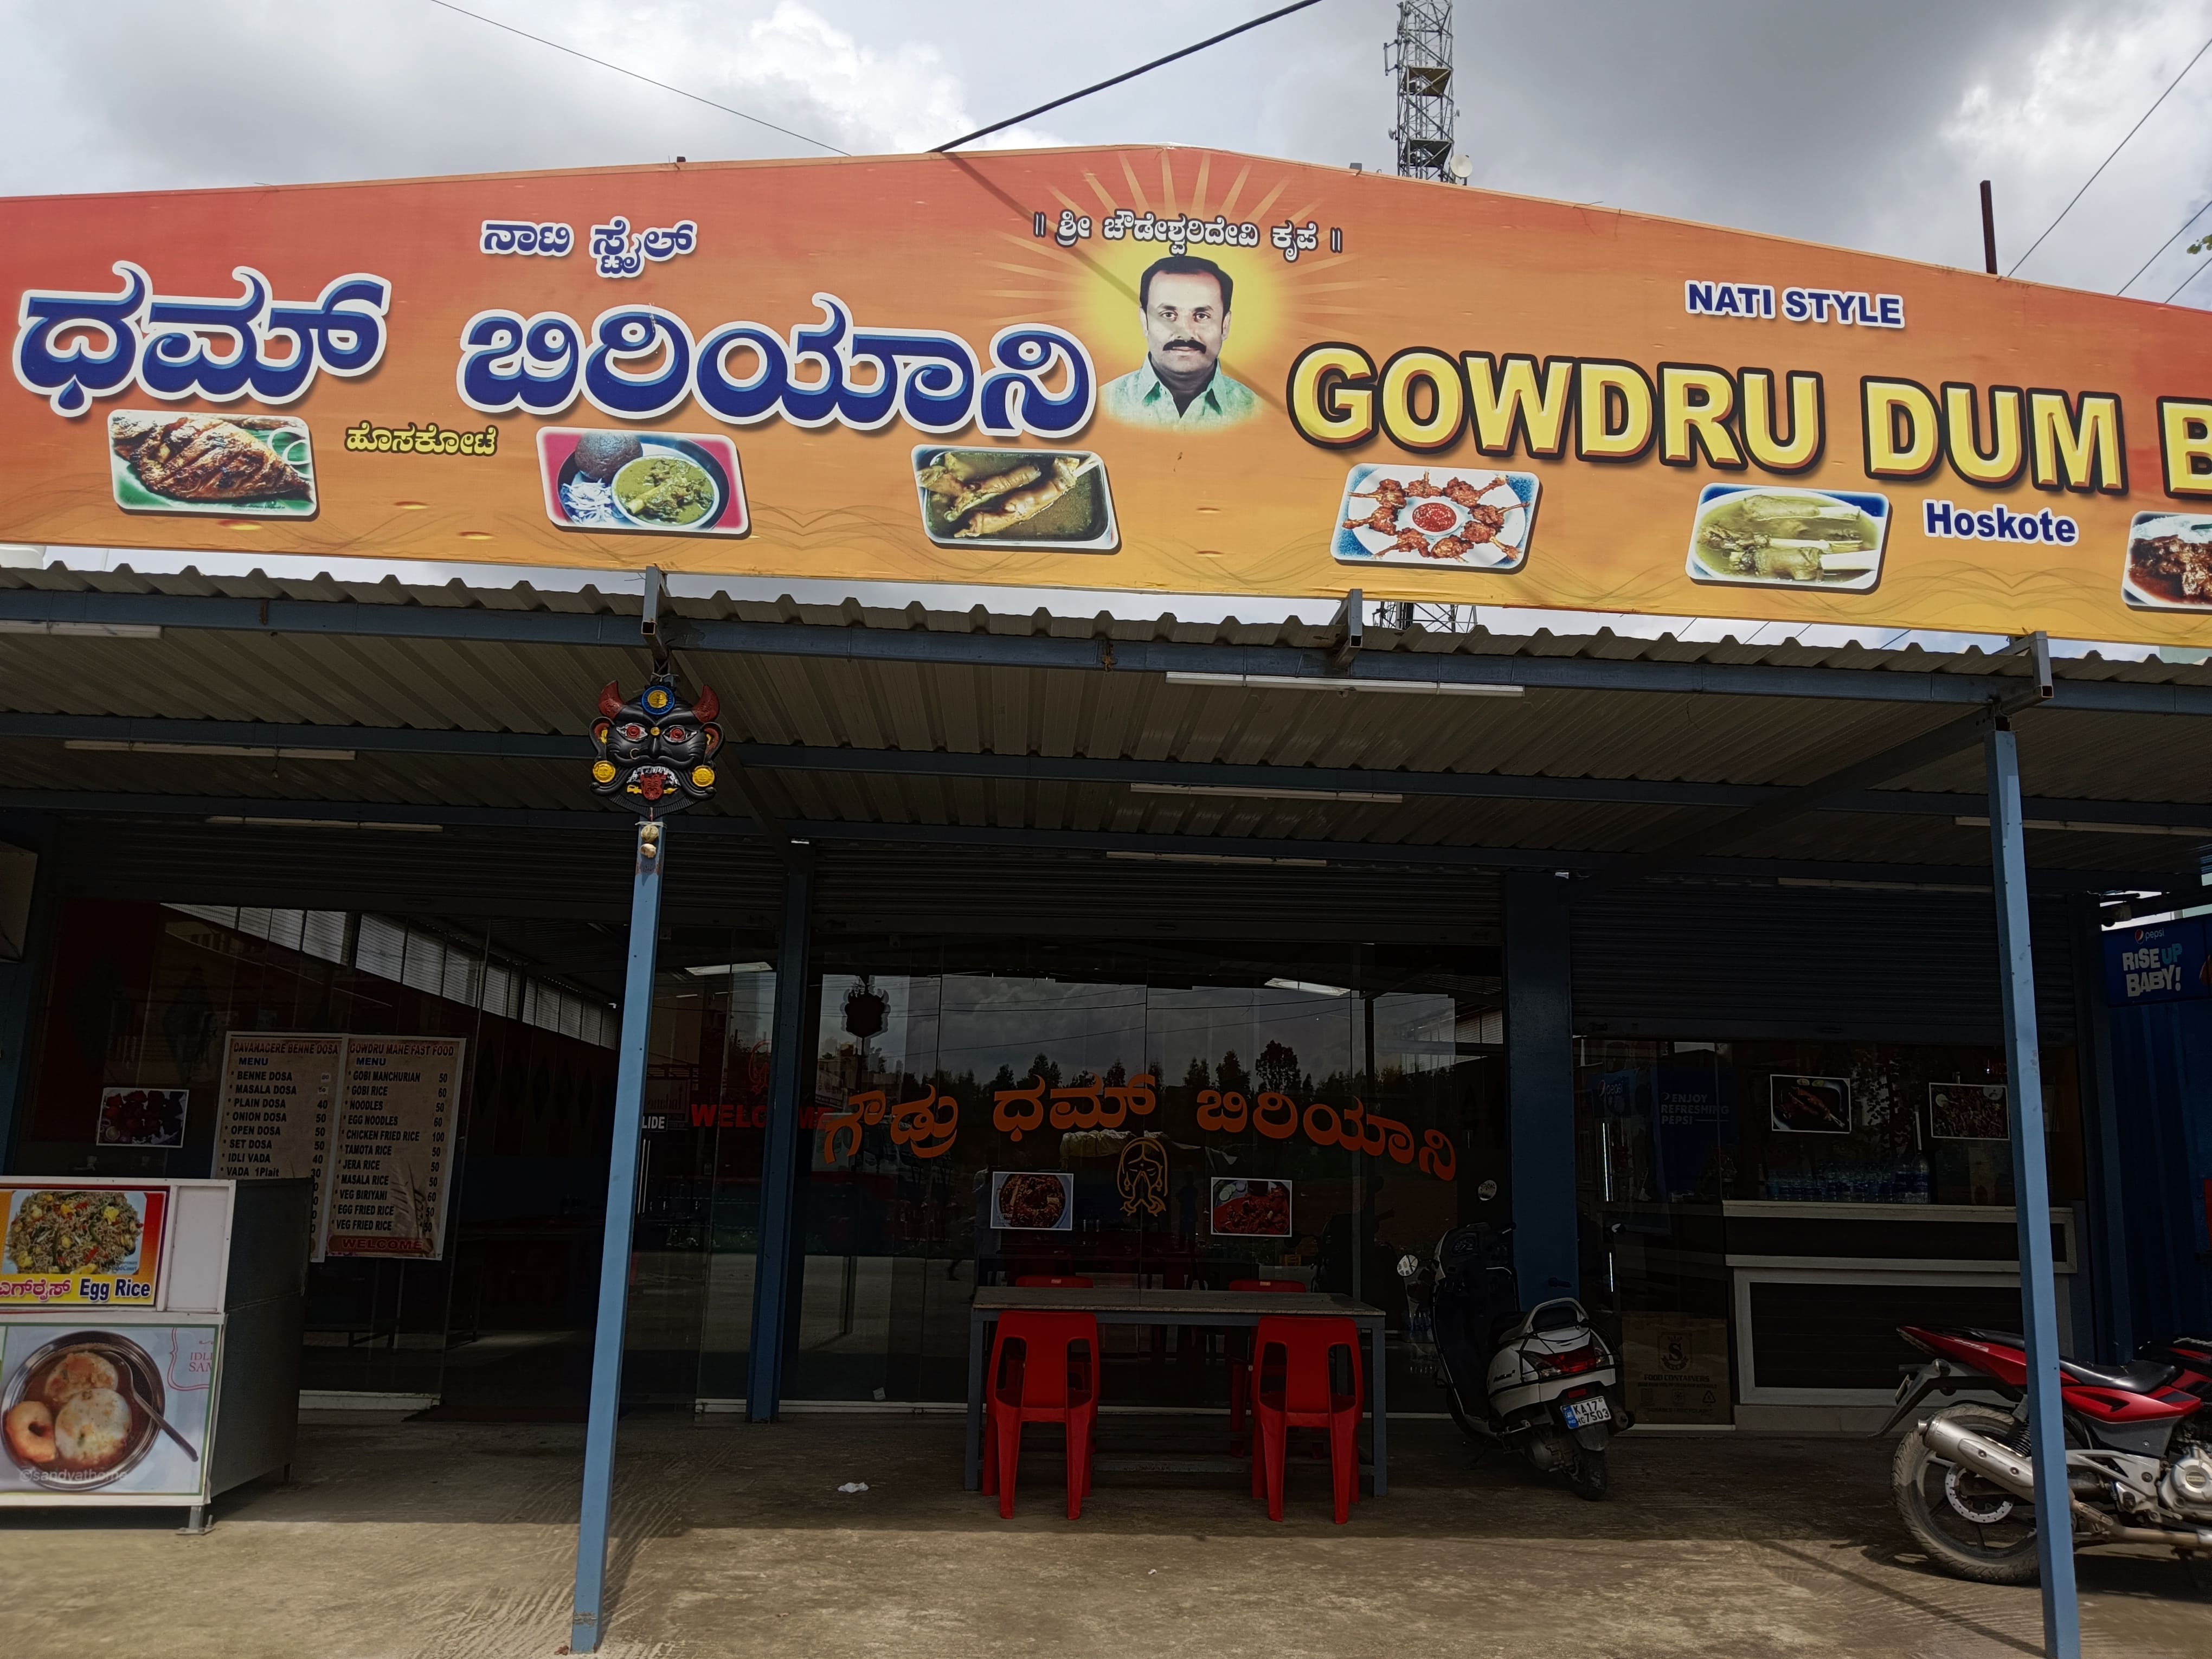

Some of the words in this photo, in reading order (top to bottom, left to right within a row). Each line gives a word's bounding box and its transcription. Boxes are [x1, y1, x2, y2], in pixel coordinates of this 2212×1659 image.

[1057, 211, 1091, 246] ಶ್ರೀ
[1103, 210, 1259, 254] ಚೌಡೇಶ್ವರಿದೇವಿ
[1272, 222, 1318, 261] ಕೃಪೆ
[483, 222, 571, 254] ನಾಟಿ
[591, 218, 695, 276] ಸ್ಟೈಲ್
[1688, 282, 1773, 318] NATI
[1784, 288, 1902, 326] STYLE
[19, 265, 387, 413] ಧಮ್
[462, 294, 1089, 437] ಬಿರಿಯಾನಿ
[1289, 342, 1824, 475] GOWDRU
[1862, 375, 2129, 495] DUM
[346, 421, 498, 456] ಹೊಸಕೋಟೆ
[1926, 499, 2079, 544] Hoskote
[2145, 928, 2165, 942] pepsi
[2122, 948, 2160, 970] RISE
[2161, 943, 2183, 964] UP
[2126, 964, 2181, 997] BABY!
[288, 1043, 314, 1054] BENNE
[317, 1044, 338, 1054] DOSA
[350, 1043, 384, 1054] GOWDRU
[386, 1044, 408, 1055] MANE
[410, 1045, 430, 1056] FAST
[433, 1046, 454, 1056] FOOD
[239, 1057, 268, 1066] MENU
[356, 1057, 386, 1066] MENU
[237, 1071, 266, 1081] BENNE
[269, 1071, 292, 1081] DOSA
[353, 1071, 370, 1081] GOBI
[372, 1071, 421, 1082] MANCHURIAN
[439, 1073, 448, 1083] 50
[236, 1085, 271, 1094] MASALA
[273, 1085, 297, 1095] DOSA
[352, 1085, 369, 1096] GOBI
[371, 1086, 388, 1096] RICE
[438, 1088, 447, 1098] 60
[234, 1098, 260, 1108] PLAIN
[262, 1099, 286, 1108] DOSA
[317, 1100, 328, 1109] 40
[1671, 1093, 1708, 1103] ENJOY
[350, 1100, 383, 1111] NOODLES
[436, 1103, 445, 1113] 50
[1661, 1104, 1730, 1115] REFRESHING
[233, 1112, 260, 1122] ONION
[263, 1113, 287, 1122] DOSA
[316, 1114, 326, 1123] 50
[348, 1115, 363, 1124] EGG
[364, 1116, 398, 1126] NOODLES
[434, 1117, 442, 1127] 60
[642, 1116, 665, 1129] LIDE
[691, 1103, 833, 1130] WELCME
[1661, 1115, 1693, 1125] PEPSI
[231, 1126, 254, 1135] OPEN
[258, 1126, 280, 1136] DOSA
[315, 1128, 325, 1137] 50
[823, 1084, 959, 1165] ಗೌಡ್ರು
[993, 1073, 1156, 1142] ಧಮ್
[1196, 1089, 1457, 1182] ಬಿರಿಯಾನಿ
[346, 1130, 378, 1140] CHICKEN
[380, 1131, 401, 1141] FRIED
[403, 1131, 420, 1141] RICE
[432, 1132, 445, 1142] 100
[230, 1140, 246, 1148] SET
[249, 1140, 272, 1149] DOSA
[314, 1141, 325, 1150] 50
[345, 1144, 373, 1155] TAMOTA
[375, 1146, 392, 1155] RICE
[432, 1147, 441, 1157] 50
[228, 1153, 245, 1162] IDLI
[248, 1154, 271, 1163] VADA
[313, 1155, 323, 1163] 40
[343, 1160, 361, 1169] JERA
[363, 1160, 380, 1170] RICE
[431, 1162, 439, 1172] 50
[227, 1167, 249, 1176] VADA
[311, 1168, 321, 1178] 30
[341, 1174, 370, 1185] MASALA
[372, 1175, 389, 1185] RICE
[429, 1177, 438, 1187] 50
[340, 1189, 354, 1199] VEG
[356, 1190, 387, 1200] BIRIYANI
[428, 1192, 436, 1202] 60
[338, 1205, 352, 1214] EGG
[355, 1205, 375, 1216] FRIED
[377, 1206, 394, 1216] RICE
[426, 1207, 434, 1217] 50
[337, 1219, 350, 1230] VEG
[352, 1220, 373, 1230] FRIED
[375, 1221, 392, 1231] RICE
[424, 1223, 432, 1232] 50
[343, 1239, 422, 1250] WELCOME
[80, 1278, 110, 1301] Egg
[115, 1278, 151, 1297] Rice
[190, 1352, 213, 1360] IDLI
